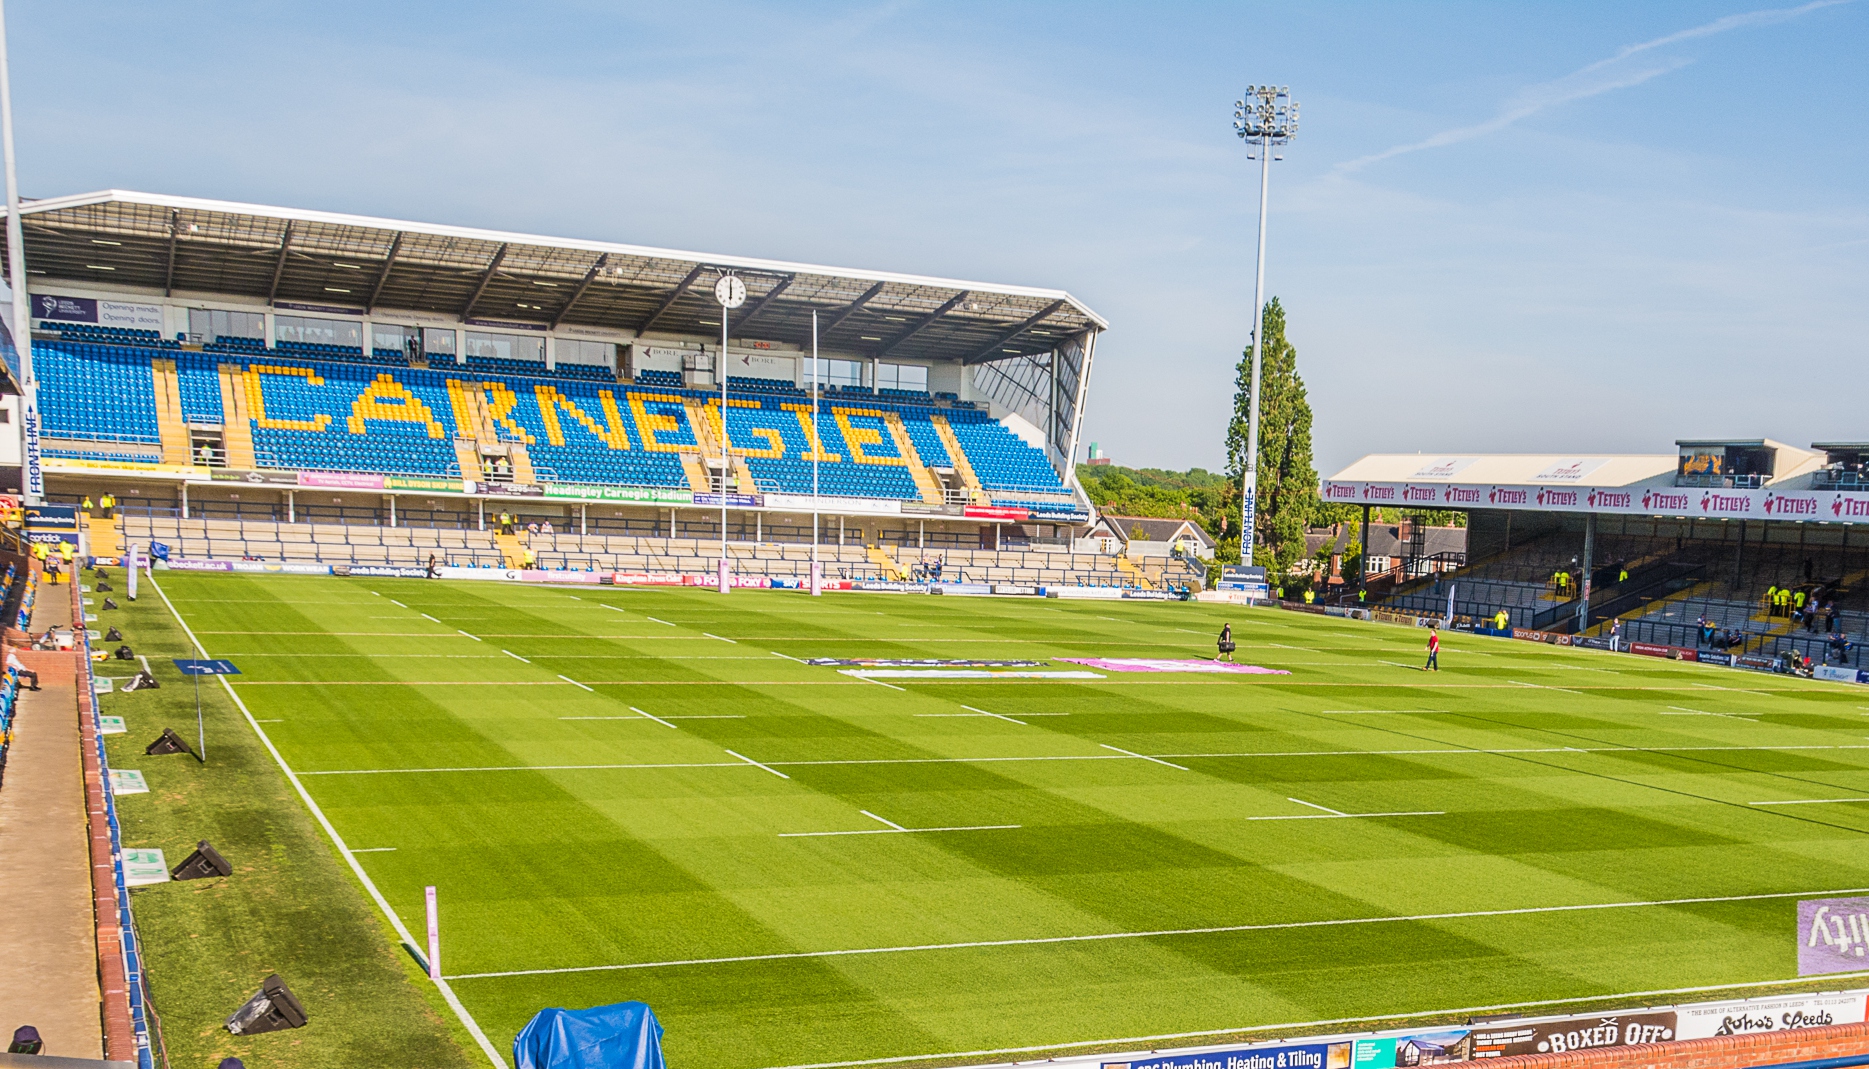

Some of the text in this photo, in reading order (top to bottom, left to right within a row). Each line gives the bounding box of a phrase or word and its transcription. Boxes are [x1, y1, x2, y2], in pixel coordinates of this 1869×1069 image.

[102, 302, 159, 314] Opening minds.
[102, 312, 160, 324] Opening doors.
[243, 362, 905, 467] CARNEGIE
[26, 412, 41, 494] FRONTLINE
[544, 485, 602, 499] Headingley
[604, 488, 650, 500] Carnegie
[651, 490, 692, 502] Stadium
[1332, 484, 1356, 498] TETLEY'S
[1370, 485, 1394, 500] TETLEY'S
[1410, 486, 1436, 501] TETLEY'S
[1452, 487, 1480, 503] TETLEY'S
[1497, 488, 1526, 504] TETLEY'S
[1545, 490, 1577, 506] TETLEY'S
[1597, 491, 1631, 508] TETLEY'S
[1652, 492, 1688, 510] TETLEY'S
[1712, 494, 1750, 512] TETLEY'S
[1776, 496, 1817, 514] TETLEY'S
[1242, 494, 1254, 556] FRONTLINE
[232, 563, 329, 573] TROJAN WORKWEAR
[648, 574, 666, 583] Press
[738, 578, 761, 587] FOXY
[783, 577, 840, 589] sky SRTS
[862, 582, 880, 590] Leeds
[906, 583, 928, 592] Society
[1703, 1008, 1718, 1016] HOME
[1727, 1004, 1759, 1012] ALTERNATIVE
[1714, 1013, 1773, 1036] Soho's
[1548, 1022, 1666, 1053] BOXED OFF
[1228, 1054, 1274, 1069] Heating
[1277, 1052, 1287, 1068] &
[1288, 1050, 1322, 1068] Tiling
